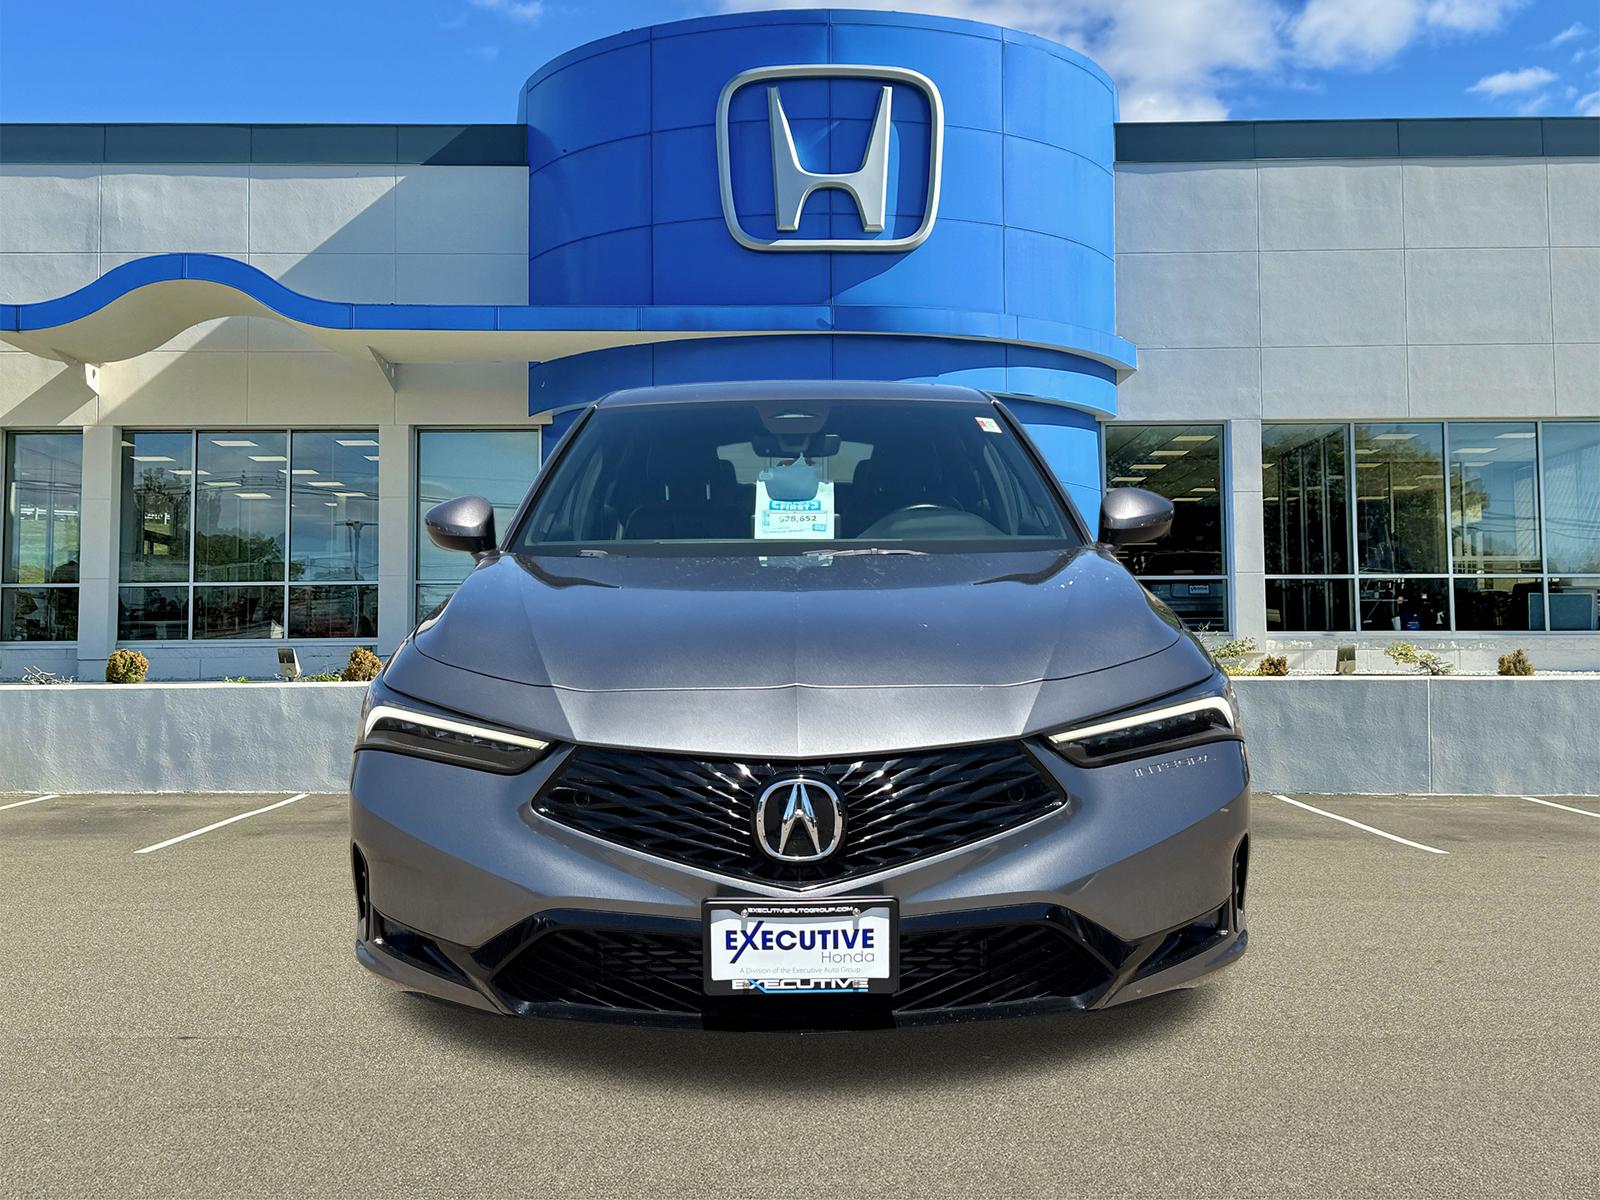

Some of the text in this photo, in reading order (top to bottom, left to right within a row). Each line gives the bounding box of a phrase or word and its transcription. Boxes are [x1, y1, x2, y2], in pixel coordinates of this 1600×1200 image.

[747, 907, 853, 915] EXECUTIVEAUTOGROUP.COM
[725, 920, 875, 964] EXECUTIVE
[821, 950, 875, 964] Honda
[840, 967, 861, 975] Group
[732, 978, 869, 991] EXECUTIVE
